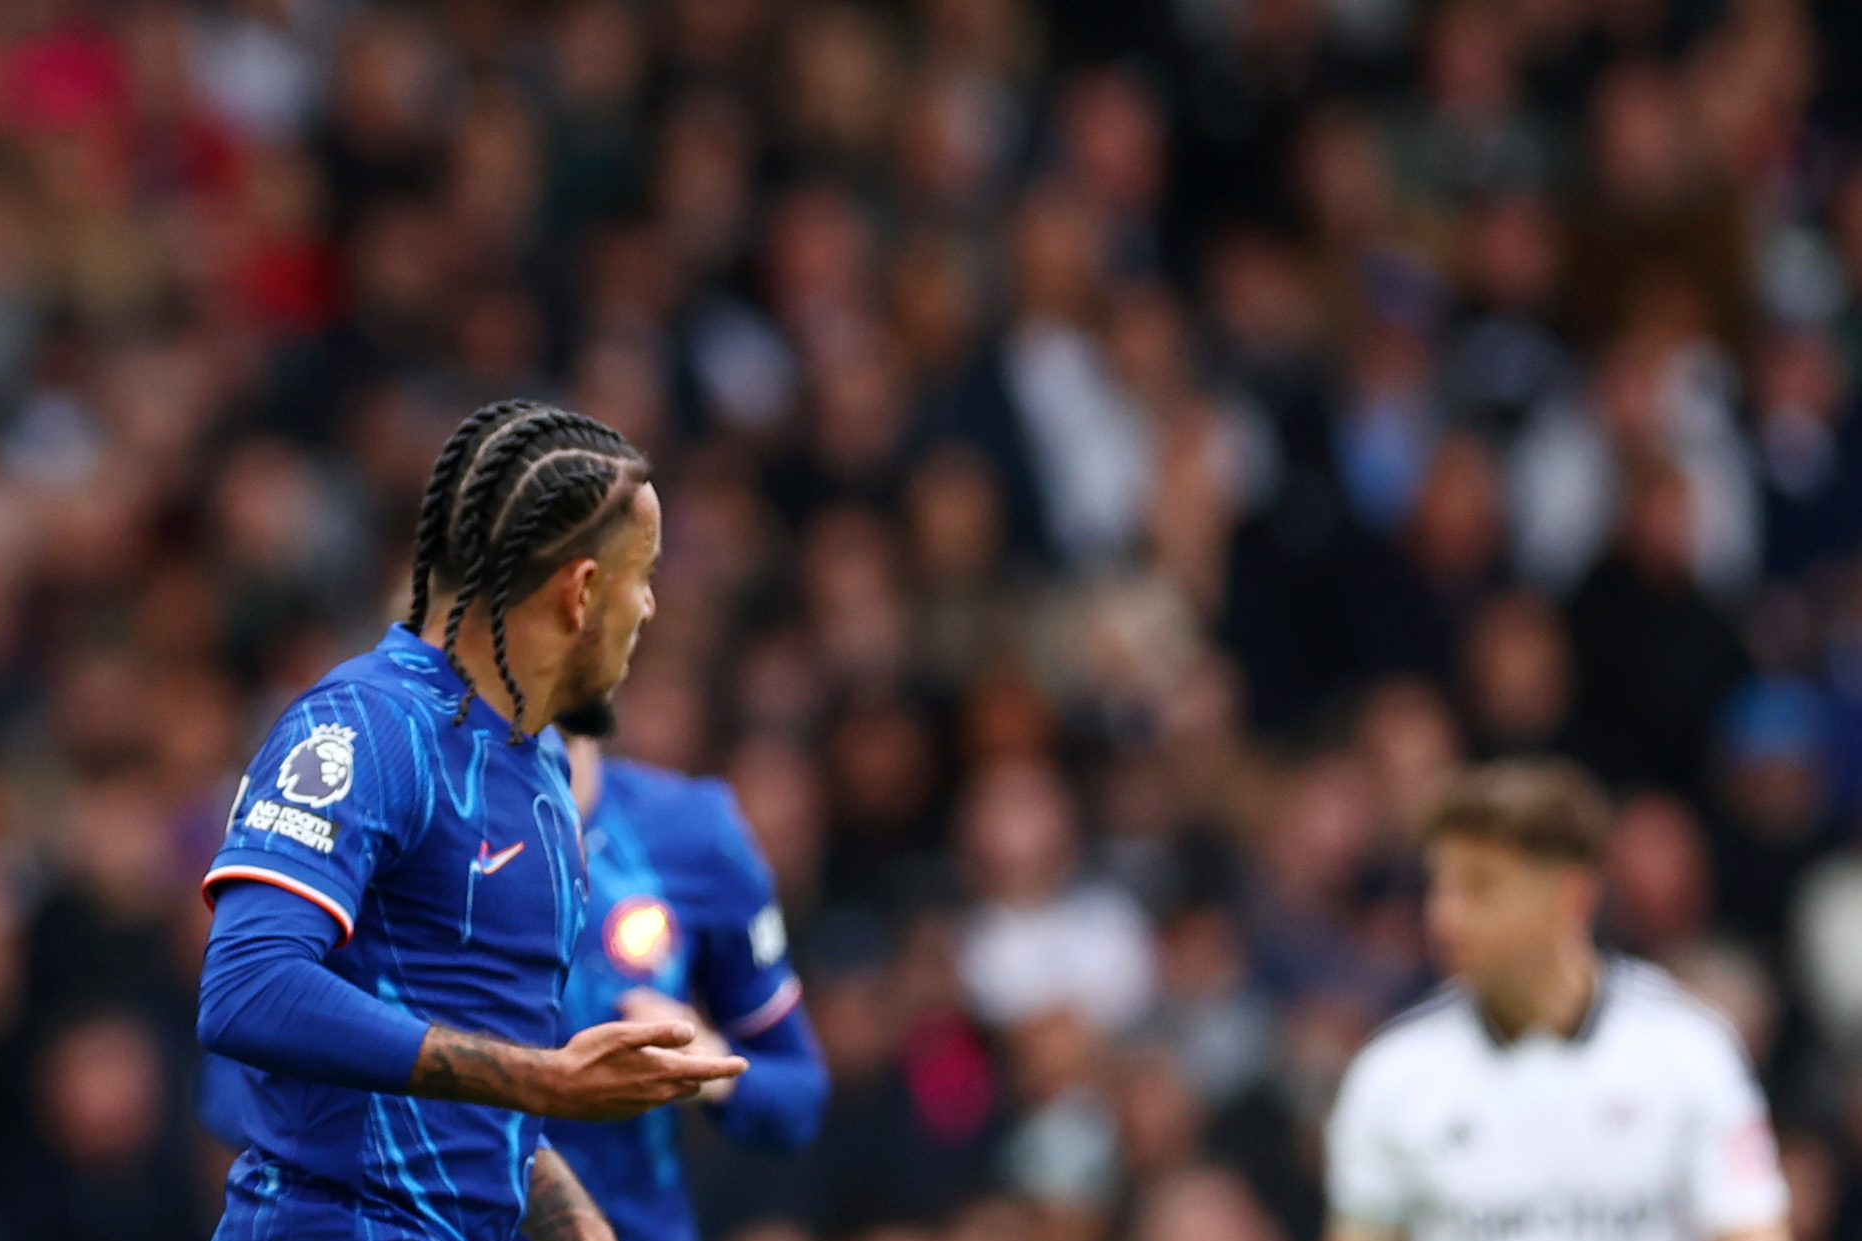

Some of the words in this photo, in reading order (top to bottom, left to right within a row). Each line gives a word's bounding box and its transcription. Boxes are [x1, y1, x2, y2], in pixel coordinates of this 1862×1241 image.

[250, 800, 280, 818] No
[279, 806, 333, 836] room
[272, 819, 334, 855] racism
